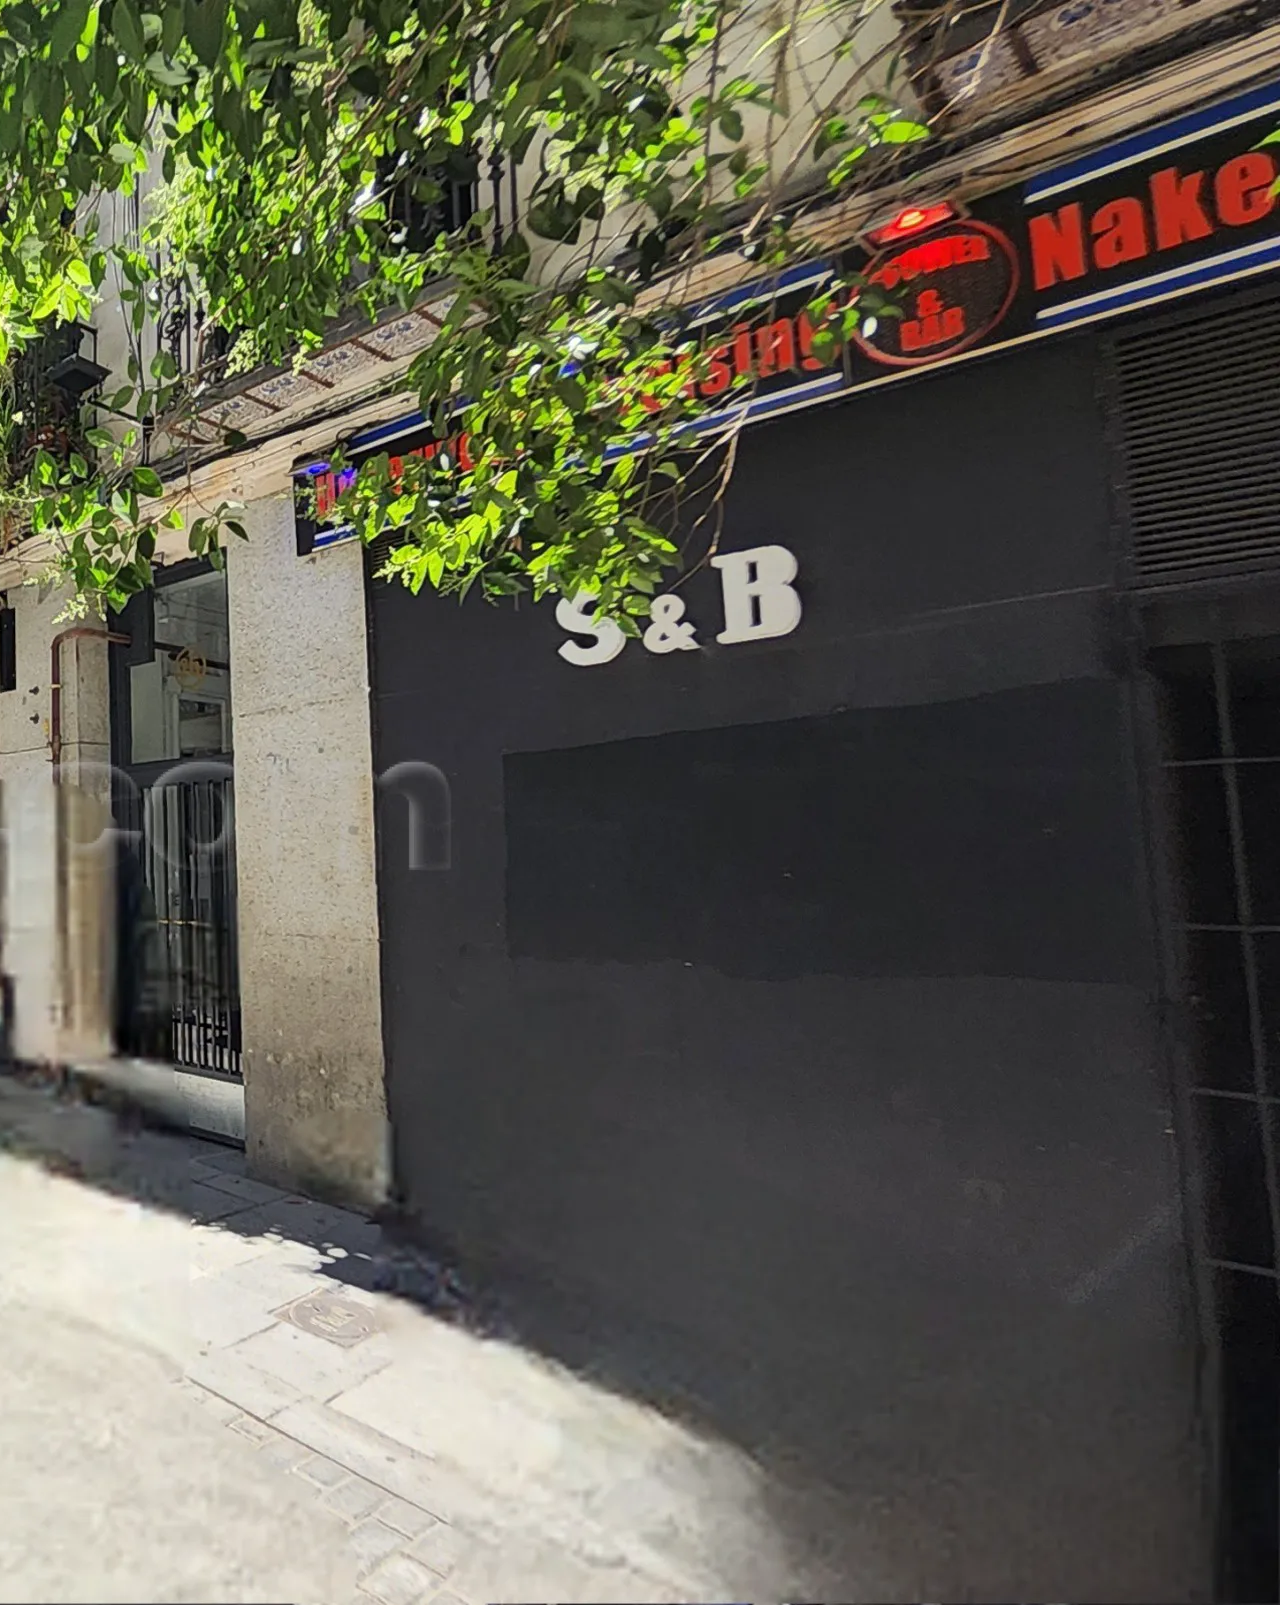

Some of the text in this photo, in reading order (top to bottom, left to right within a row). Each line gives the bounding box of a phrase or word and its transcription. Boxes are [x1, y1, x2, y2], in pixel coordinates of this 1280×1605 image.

[1028, 152, 1276, 291] Nake
[900, 306, 965, 352] BAR
[555, 544, 802, 666] S & B
